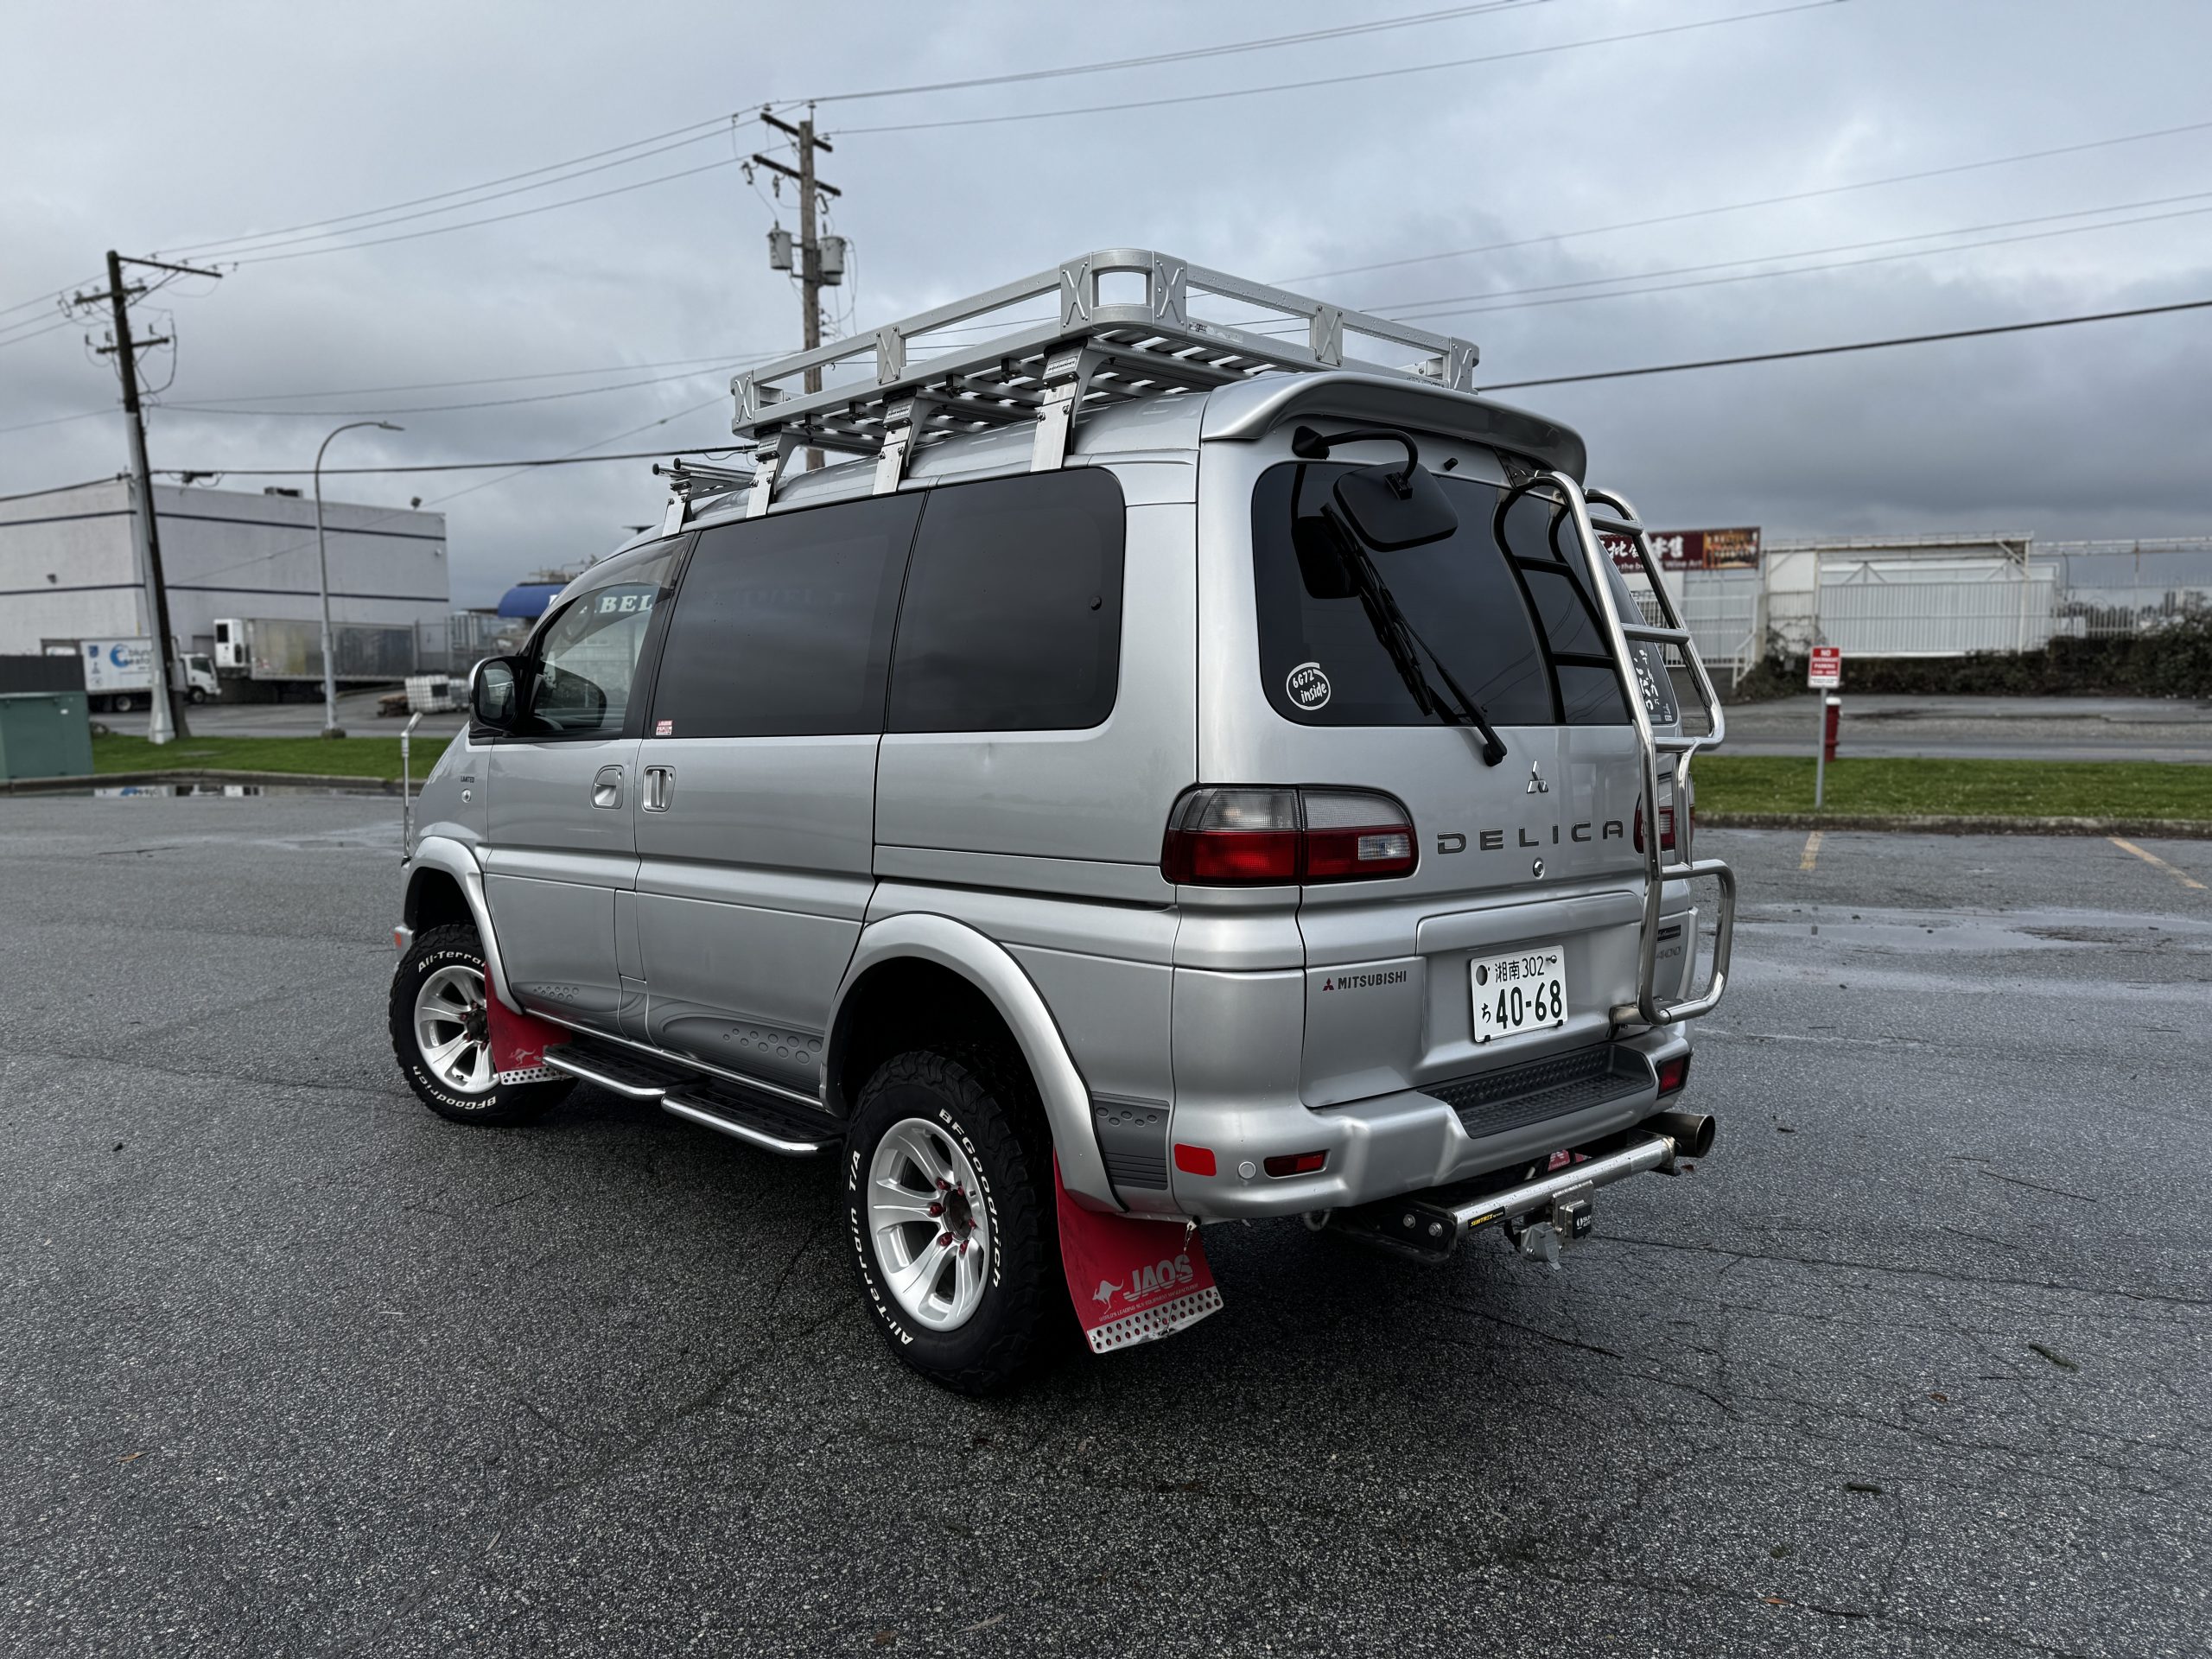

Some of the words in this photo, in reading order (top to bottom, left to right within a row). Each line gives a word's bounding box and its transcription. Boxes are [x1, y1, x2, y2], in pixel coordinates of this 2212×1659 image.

[1293, 670, 1314, 689] 6G72
[1300, 682, 1327, 703] inside
[1437, 819, 1624, 855] DELICA
[1338, 969, 1407, 990] MITSUBISHI
[1481, 1002, 1491, 1024] ち
[1496, 979, 1562, 1030] 40-68
[412, 1065, 497, 1110] BFGoodrich
[849, 1150, 861, 1192] T/A
[938, 1108, 1001, 1288] BFGoodrich
[850, 1207, 914, 1345] All-Terrain
[1122, 1254, 1193, 1302] JAOS
